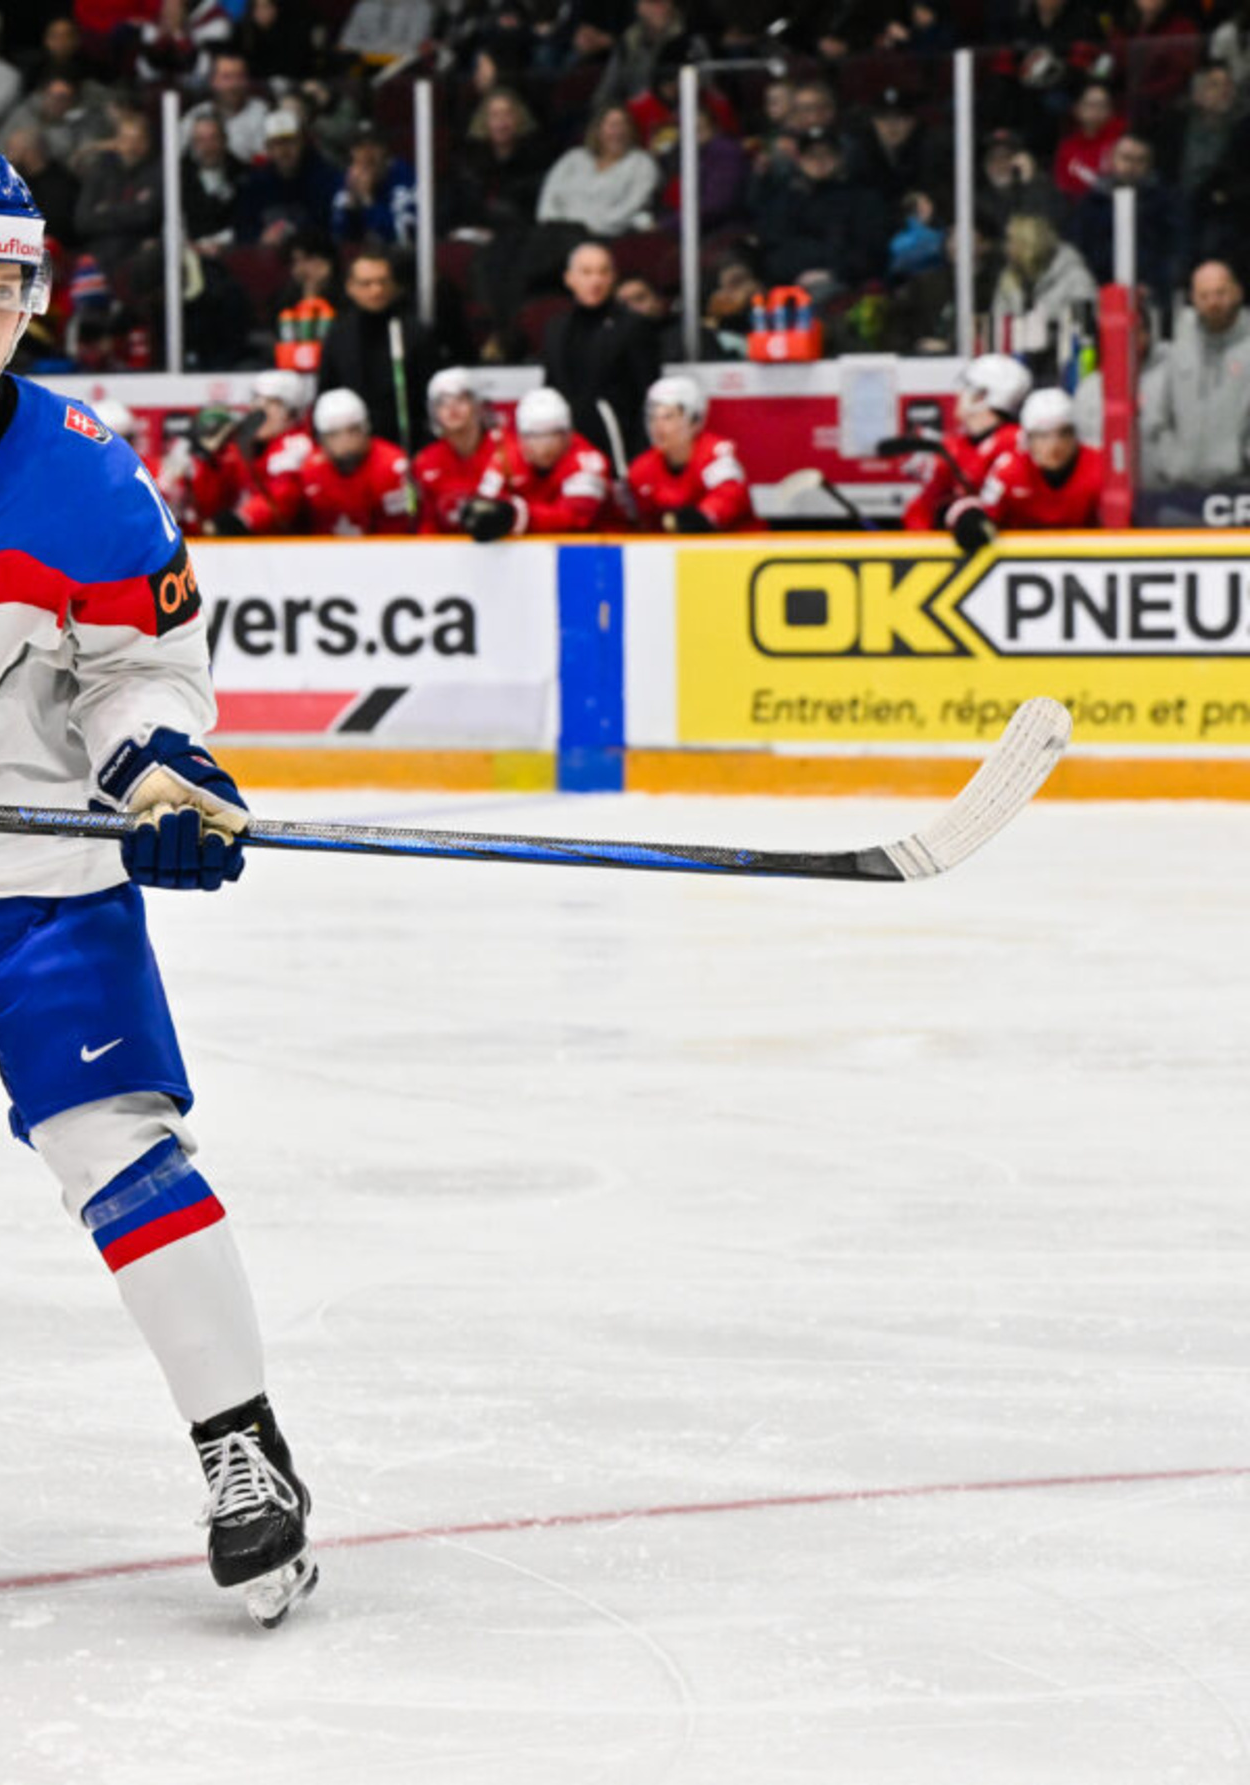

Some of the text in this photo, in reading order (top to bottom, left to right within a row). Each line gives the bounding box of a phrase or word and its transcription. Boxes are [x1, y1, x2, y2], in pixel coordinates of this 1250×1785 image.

[134, 465, 178, 543] 1
[751, 560, 959, 656] OK
[1006, 572, 1250, 641] PNEU
[751, 688, 926, 730] Entretien,
[1148, 696, 1187, 726] et
